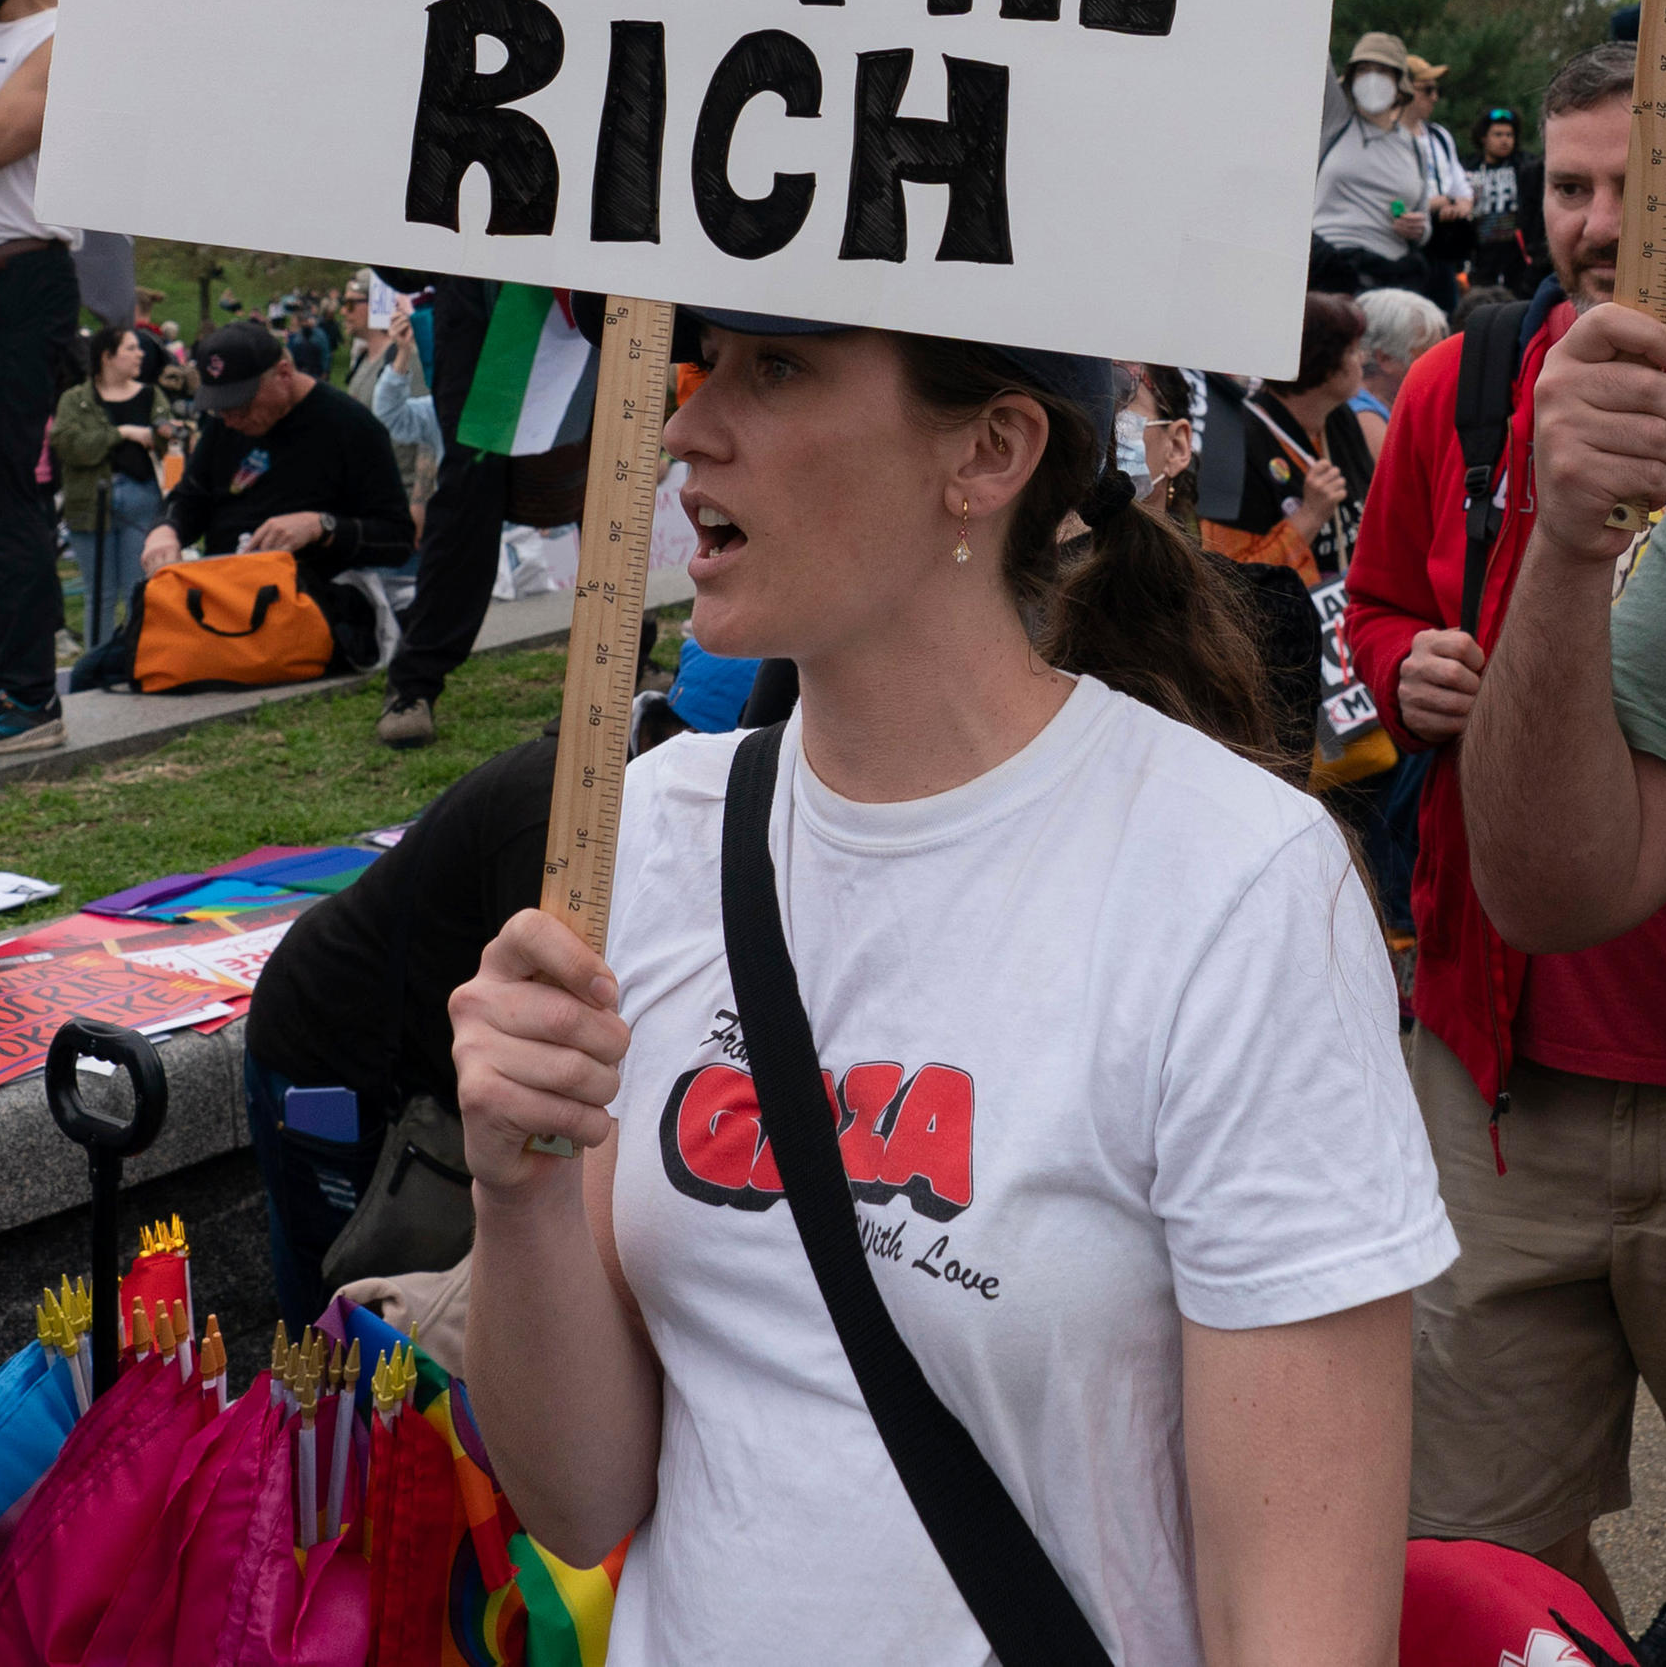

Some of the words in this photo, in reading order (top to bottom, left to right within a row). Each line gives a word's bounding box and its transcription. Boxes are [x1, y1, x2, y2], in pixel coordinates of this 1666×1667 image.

[1656, 101, 1666, 119] 27
[1651, 148, 1663, 166] 28
[1646, 195, 1658, 213] 29
[1642, 241, 1654, 259] 30
[1637, 287, 1649, 305] 31
[628, 338, 642, 360] 23
[623, 399, 636, 420] 24
[615, 460, 630, 482] 25
[609, 520, 623, 543] 26
[602, 582, 616, 605] 27
[595, 643, 610, 666] 28
[589, 705, 603, 727] 29
[582, 766, 596, 789] 30
[576, 829, 589, 849] 31
[568, 890, 583, 912] 32
[699, 1008, 751, 1067] Fro
[911, 1235, 1001, 1301] Love
